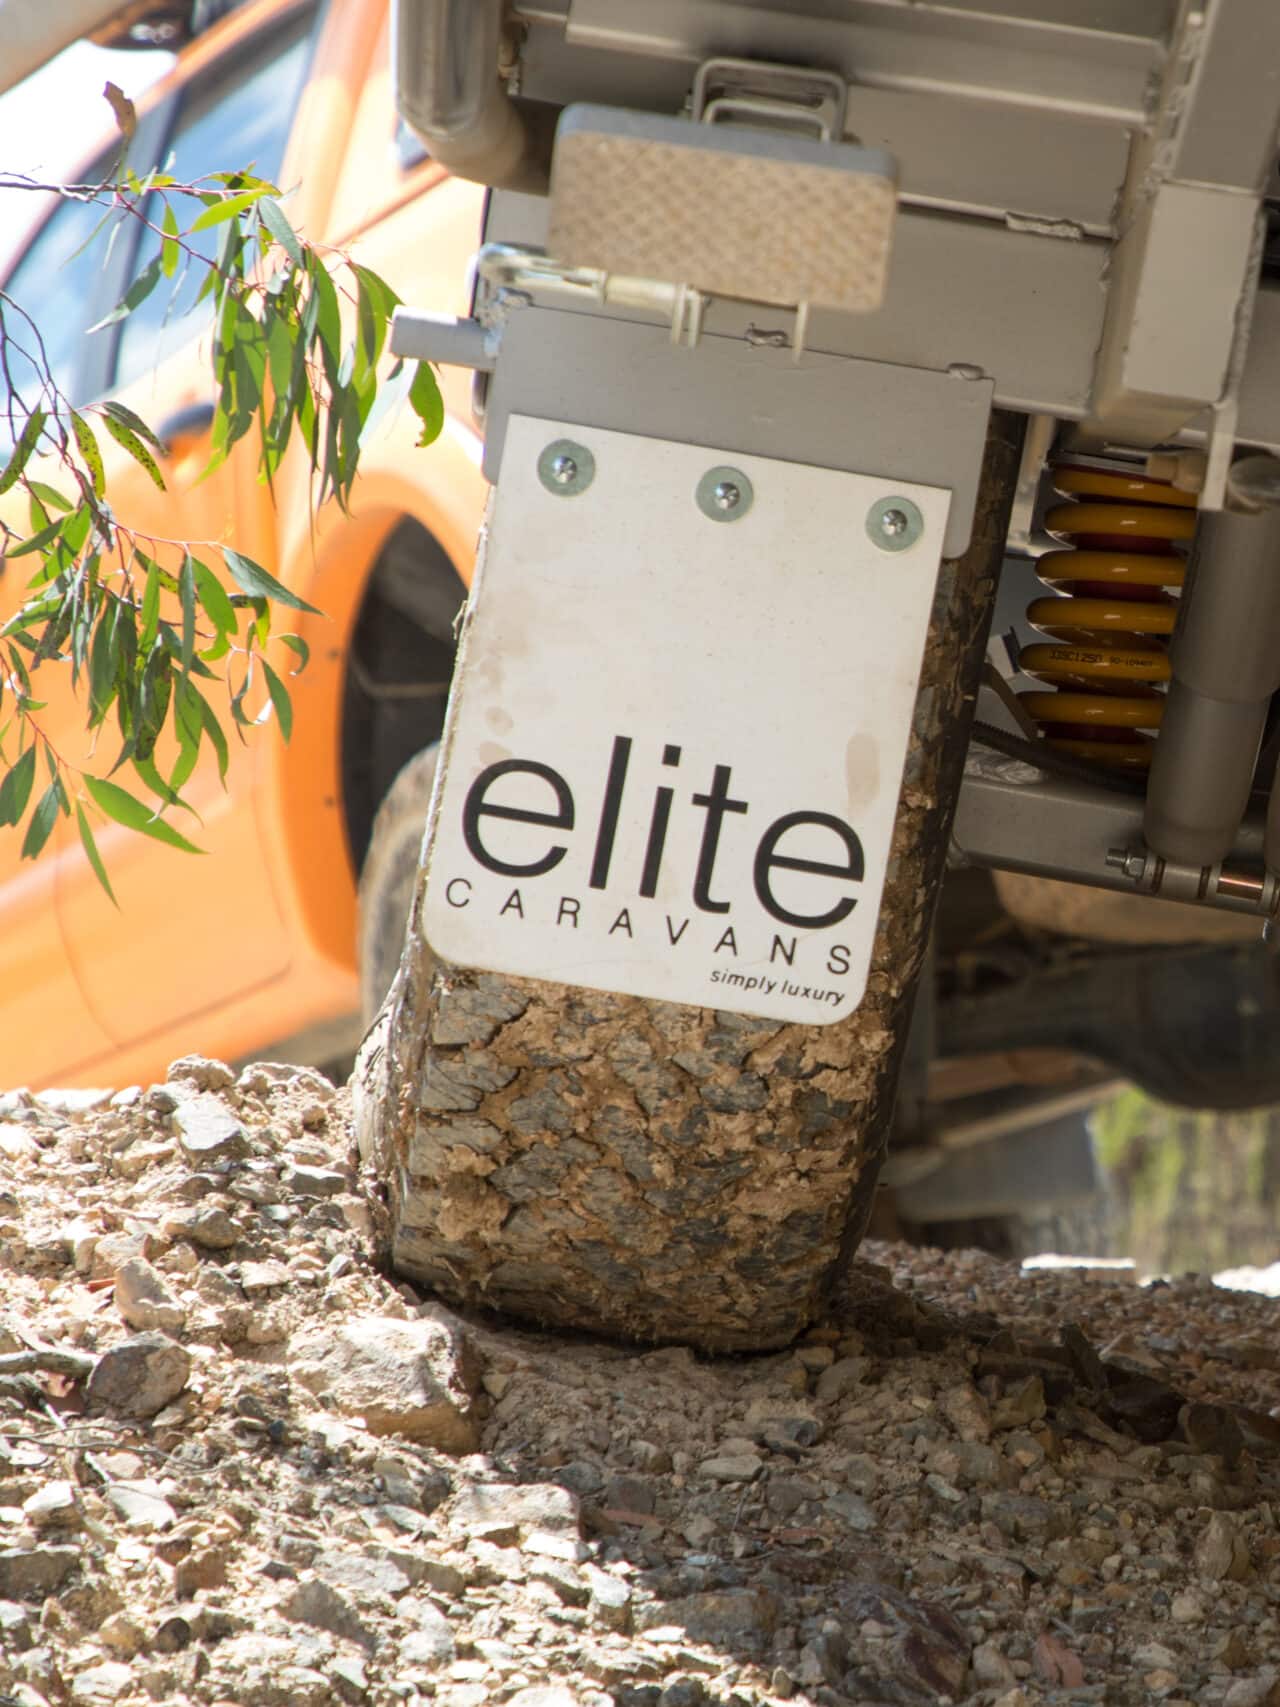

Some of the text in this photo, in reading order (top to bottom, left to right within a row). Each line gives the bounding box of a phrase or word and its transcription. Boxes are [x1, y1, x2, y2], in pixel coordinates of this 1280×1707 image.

[463, 735, 865, 930] elite
[446, 878, 851, 976] CARAVANS
[710, 968, 845, 1007] simply luxury
